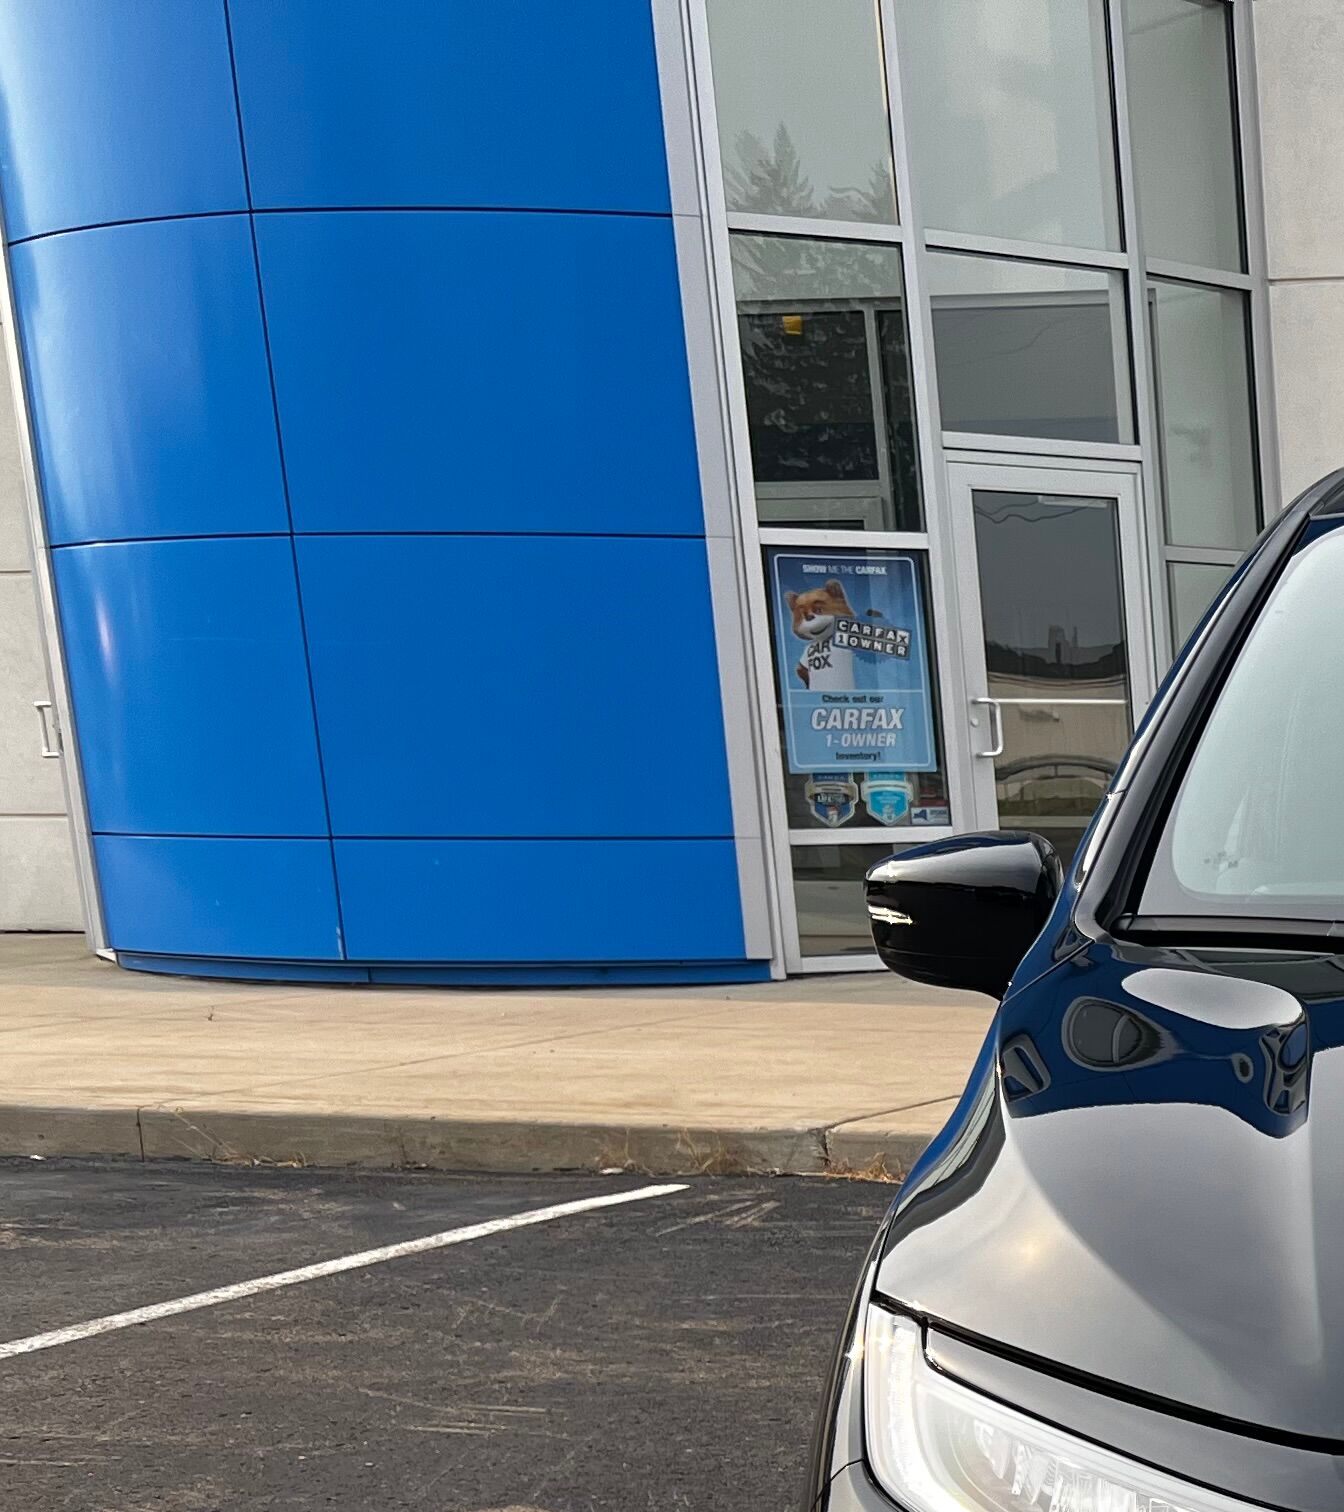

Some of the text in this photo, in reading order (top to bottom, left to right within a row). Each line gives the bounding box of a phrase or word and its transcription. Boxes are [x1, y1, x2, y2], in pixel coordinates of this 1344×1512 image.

[838, 620, 909, 645] CARFAX
[811, 708, 904, 730] CARFAX
[825, 732, 897, 748] 1-OWNER
